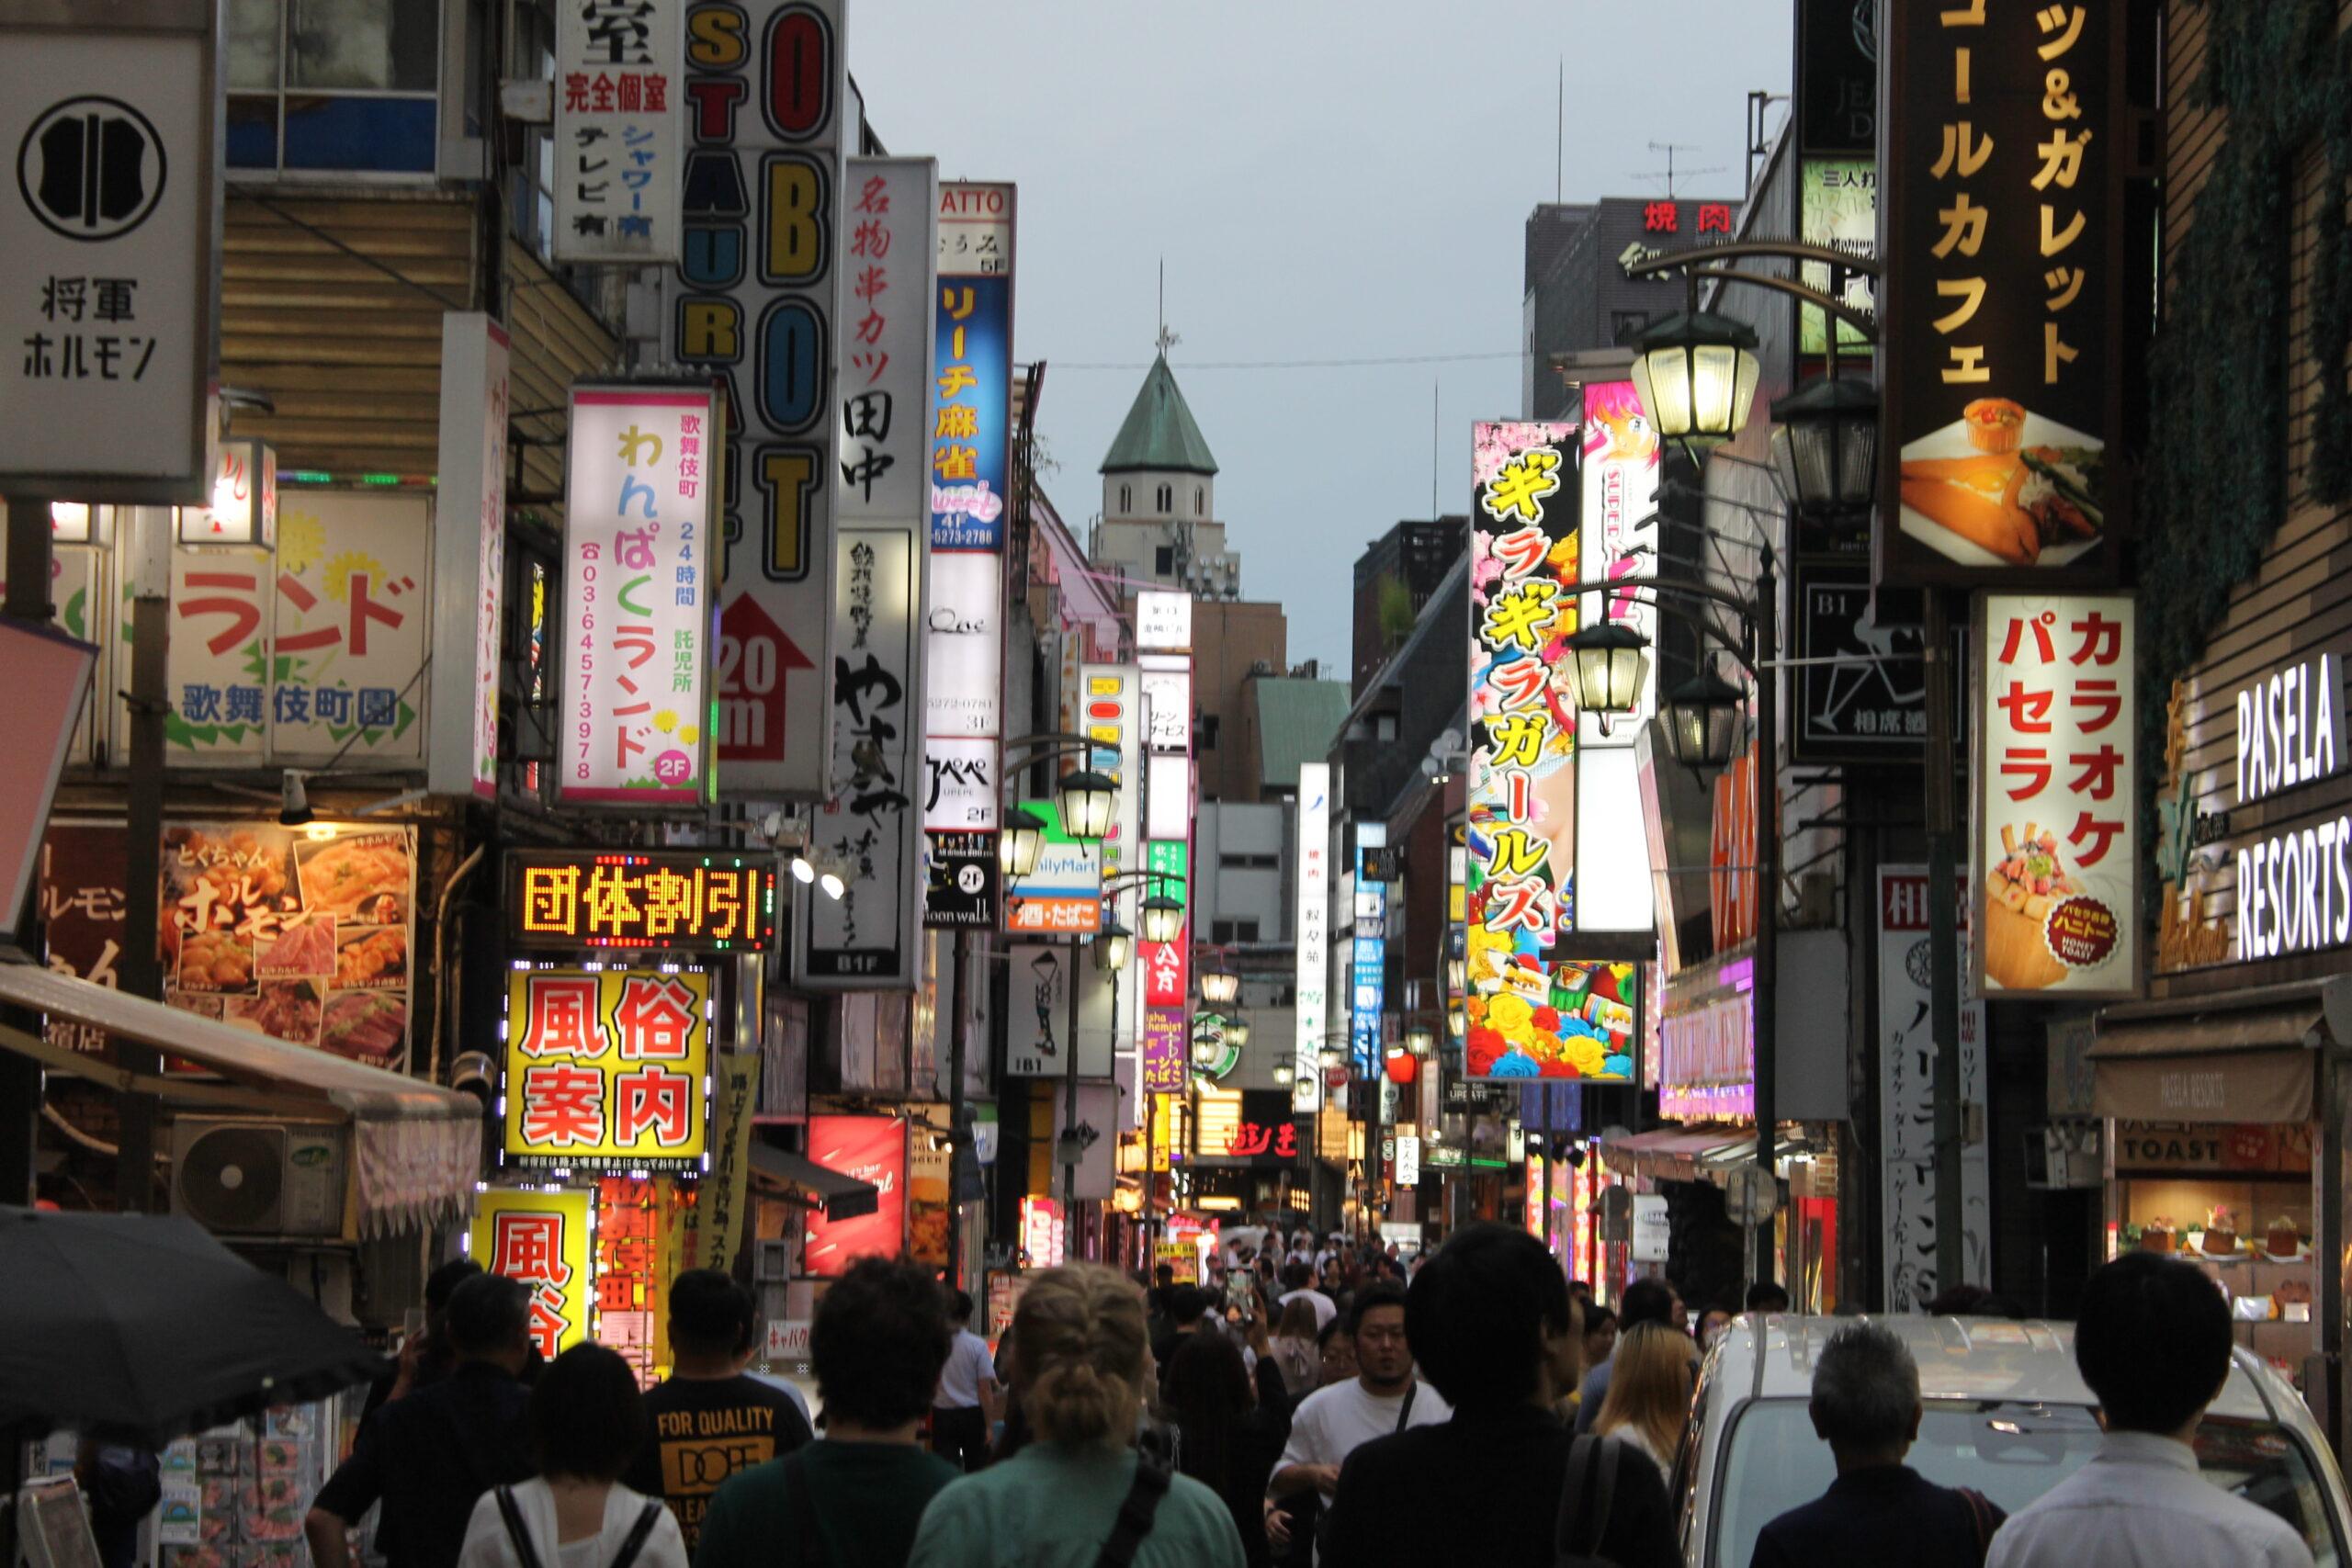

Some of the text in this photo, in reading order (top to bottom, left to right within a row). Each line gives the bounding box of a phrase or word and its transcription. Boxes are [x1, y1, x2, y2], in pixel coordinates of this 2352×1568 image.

[565, 73, 667, 113] 完全個室
[1644, 201, 1731, 233] 焼肉
[40, 276, 138, 323] 将軍
[23, 333, 156, 381] ホルモン
[934, 286, 980, 480] リーチ麻雀
[840, 389, 895, 503] 田中
[672, 413, 701, 693] 歌舞伎町 24時間 託児所
[613, 424, 663, 769] わんぱくランド
[182, 682, 396, 728] 歌舞伎町園
[1481, 447, 1561, 933] ギラギラガールズ
[1996, 610, 2056, 802] パセラ
[2067, 611, 2125, 869] カラオケ
[2236, 652, 2335, 803] PASELA
[660, 759, 685, 776] 2F
[967, 807, 992, 822] 2F
[176, 843, 270, 868] とくちゃん
[2237, 816, 2350, 962] RESORTS
[173, 875, 317, 942] ホルモン
[524, 865, 757, 940] 団体割引
[520, 974, 696, 1058] 風俗
[520, 1062, 694, 1147] 案内
[1402, 1138, 1414, 1182] とんかつ
[2123, 1139, 2221, 1161] TOAST
[658, 1406, 775, 1436] FOR QUALITY
